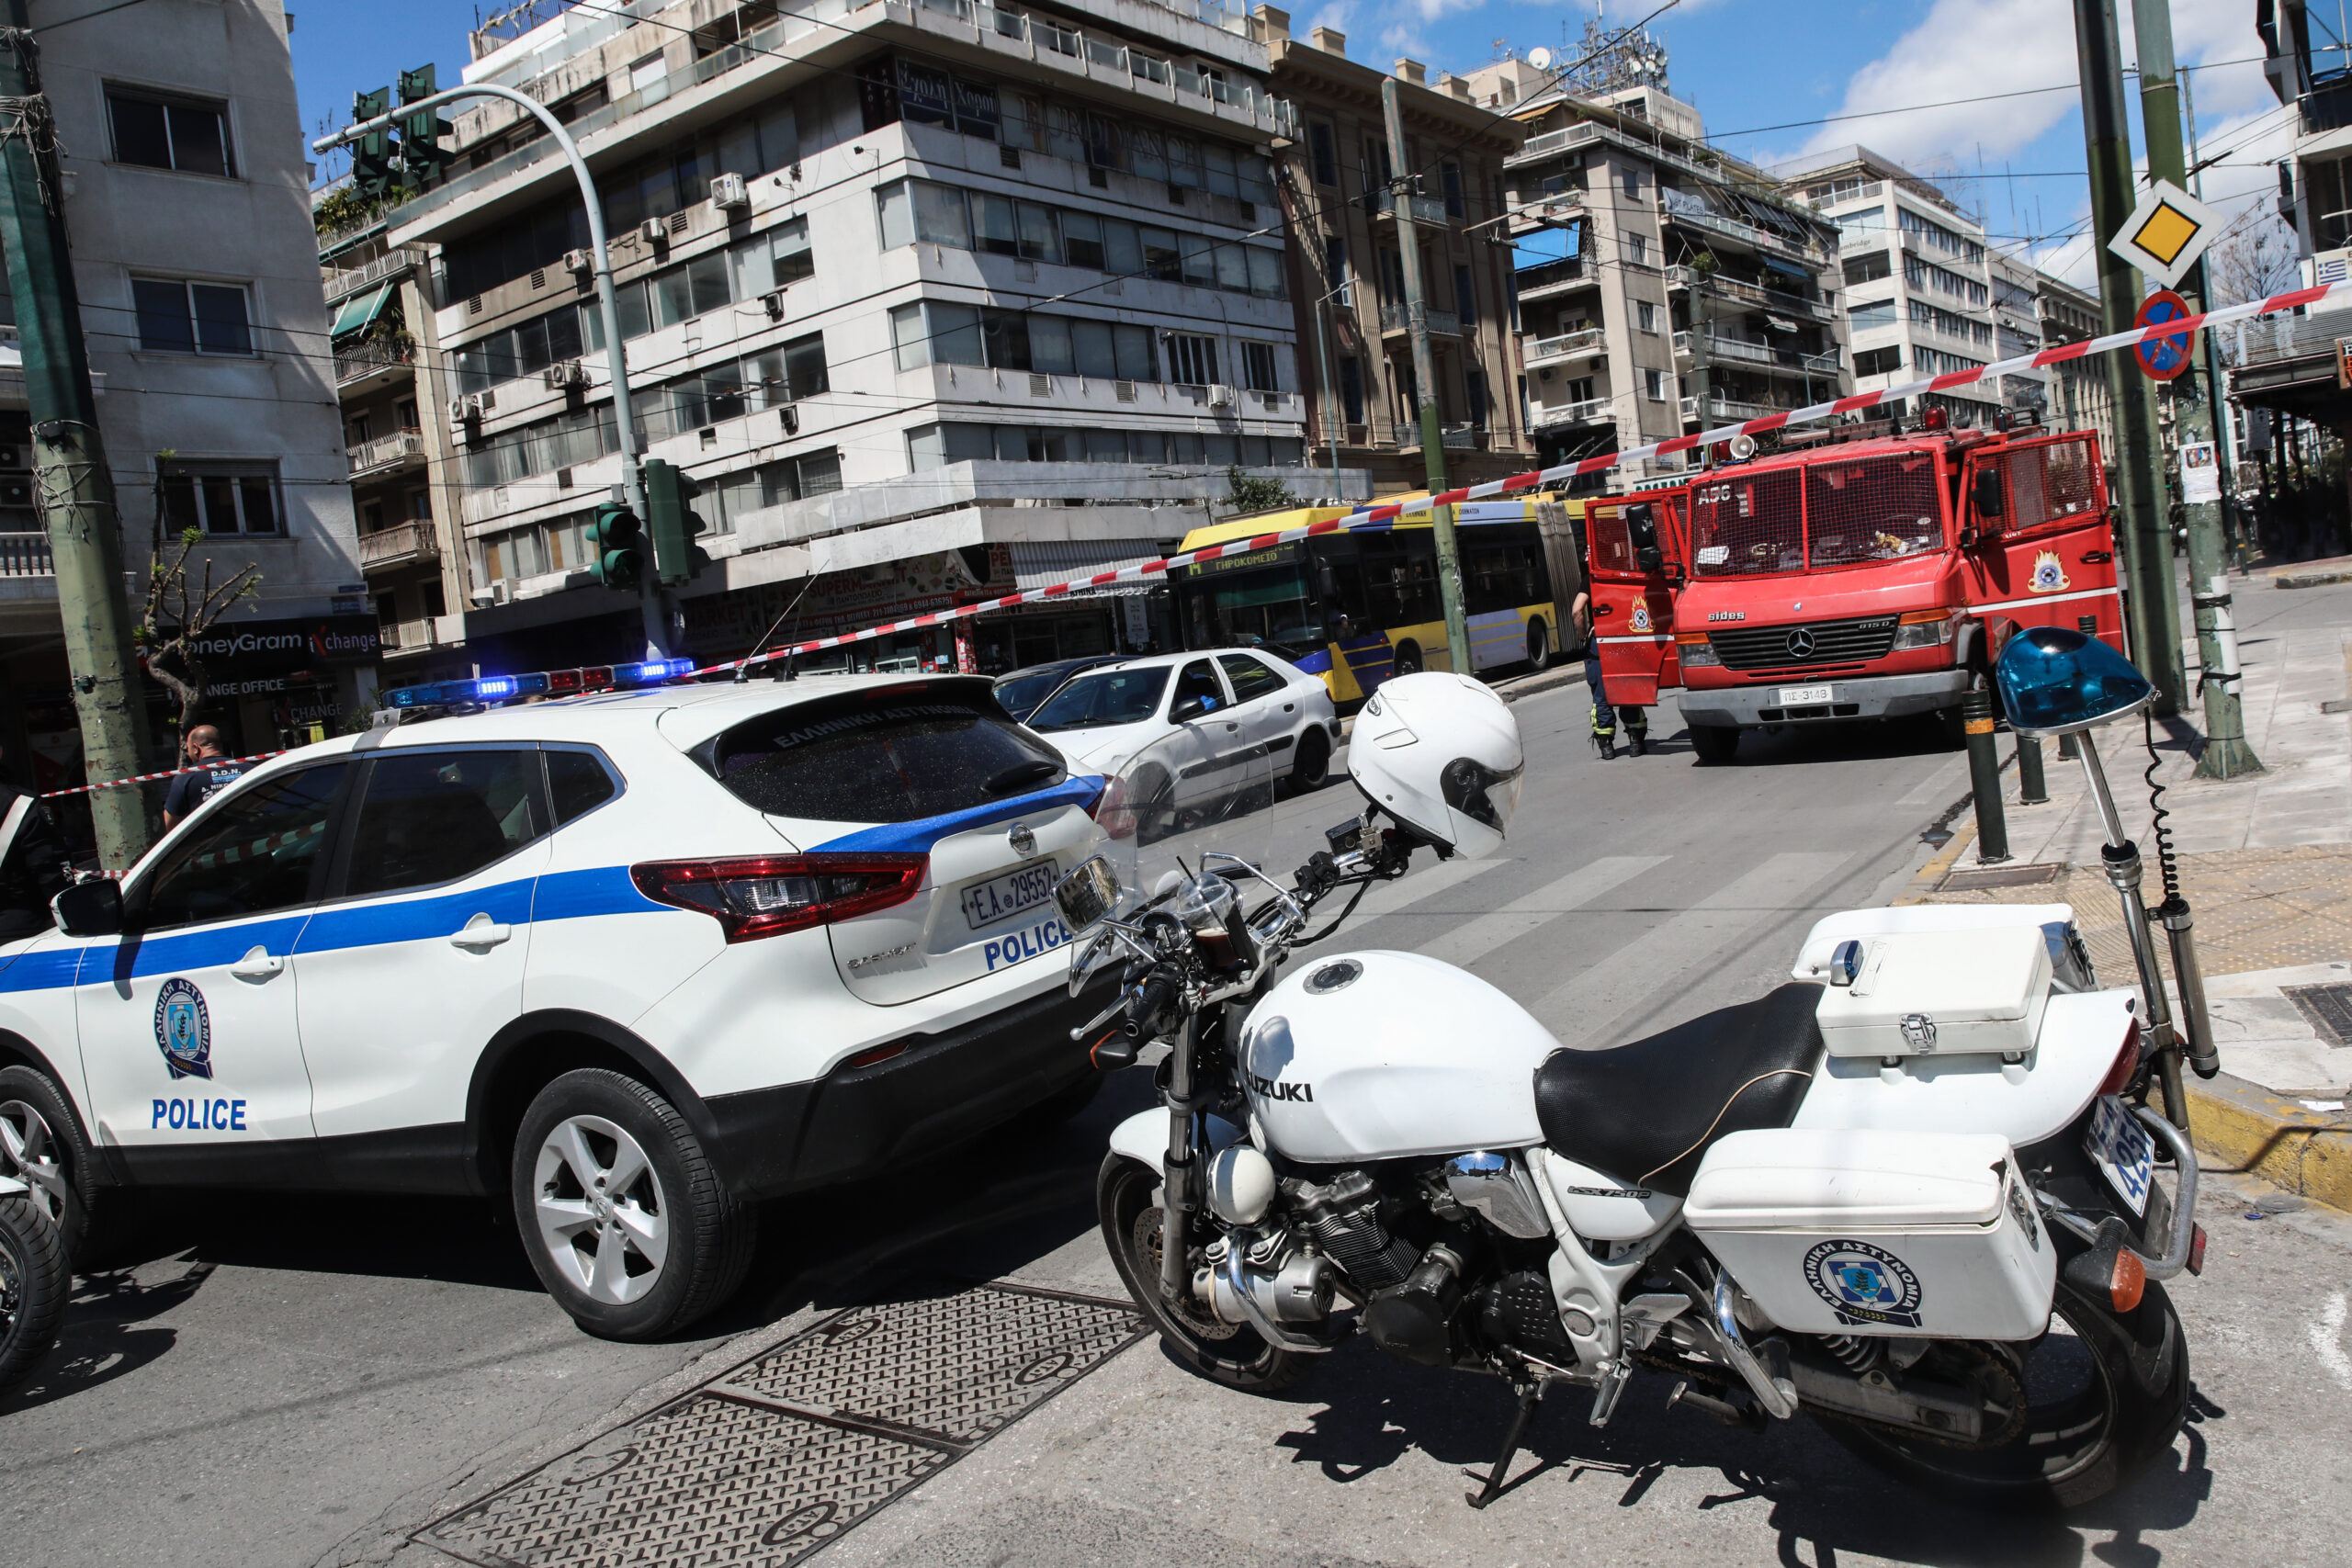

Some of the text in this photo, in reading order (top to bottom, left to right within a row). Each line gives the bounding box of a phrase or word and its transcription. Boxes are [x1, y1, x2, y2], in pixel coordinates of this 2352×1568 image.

[1839, 239, 1871, 251] ambridge
[1698, 485, 1730, 505] A56
[1216, 552, 1278, 570] ΓΗΡΟΚΟΜΕΙΟ
[809, 565, 908, 598] SUPERMT
[1708, 611, 1745, 622] sides
[242, 679, 286, 694] OFFICE
[773, 712, 884, 749] ΕΛΛΗΝΙΚΗ
[210, 768, 242, 777] D.D.N.
[1011, 866, 1052, 909] 29552
[155, 980, 209, 1055] ΕΛΛΗΝΙΚΗ ΑΣΤΥΝΟΜΙΑ
[152, 1099, 247, 1131] POLICE
[1805, 1242, 1919, 1308] ΕΛΛΗΝΙΚΗ ΑΣΤΥΝΟΜΙΑ
